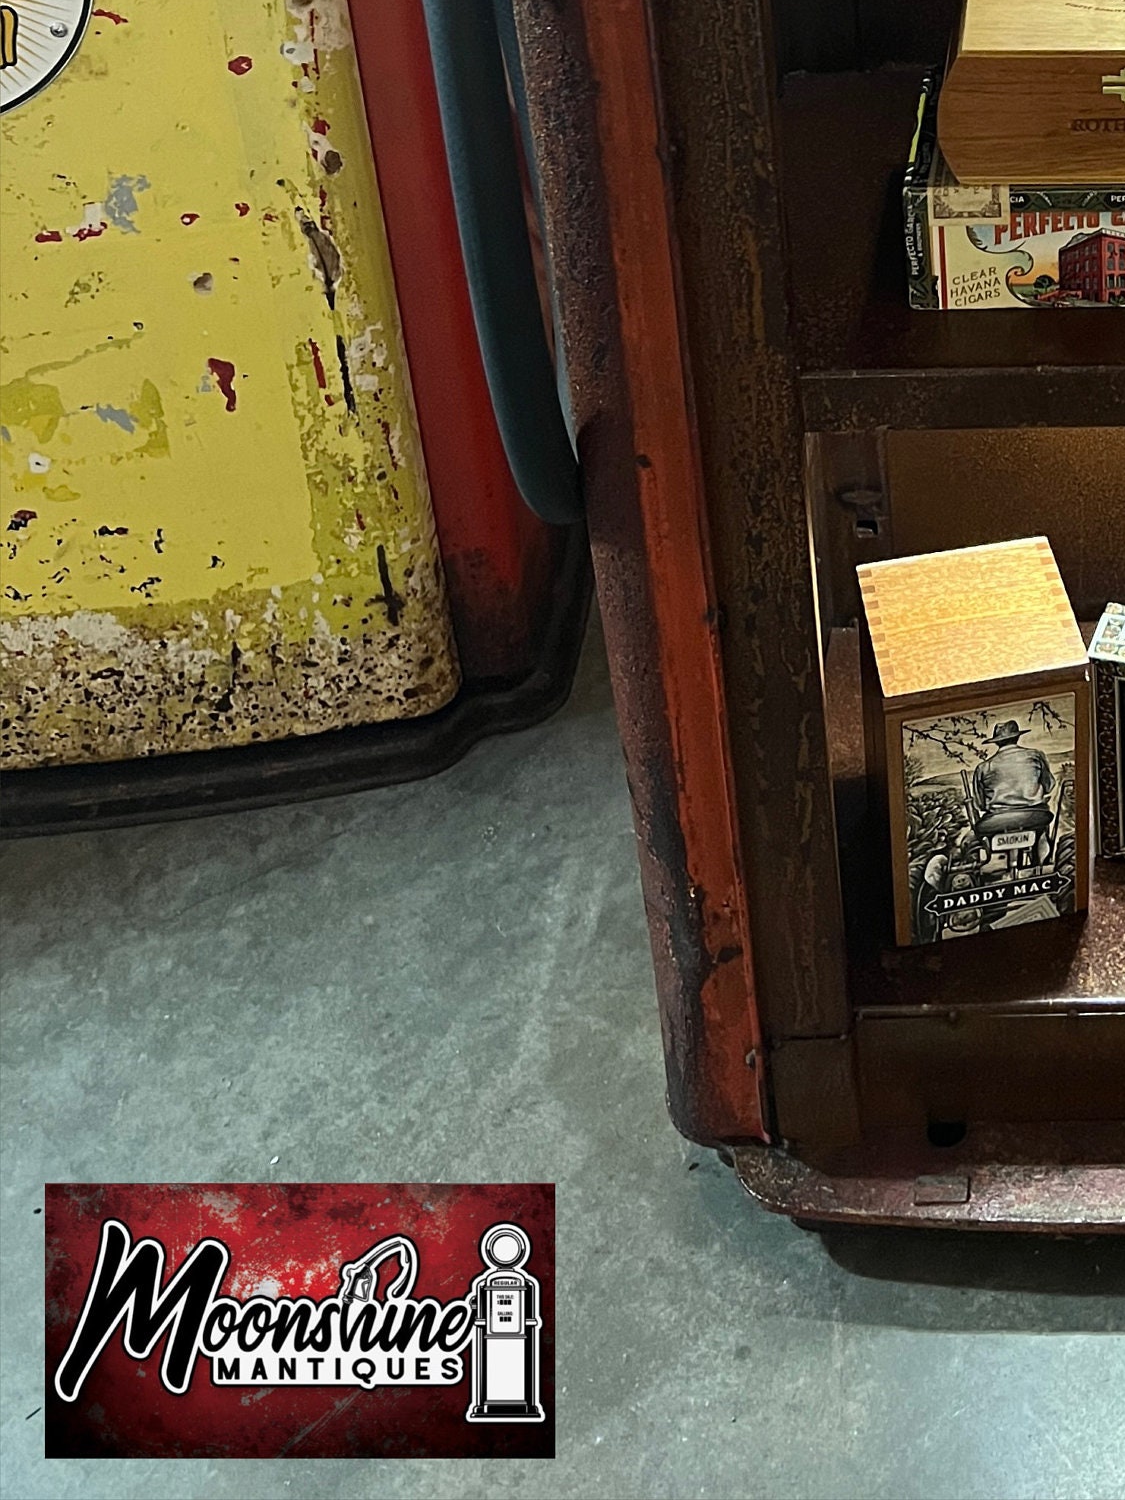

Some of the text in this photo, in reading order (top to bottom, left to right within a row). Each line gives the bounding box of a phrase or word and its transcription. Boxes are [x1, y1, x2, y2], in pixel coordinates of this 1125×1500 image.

[994, 211, 1100, 246] PERFECTO
[952, 266, 998, 286] CLEAR
[950, 277, 1001, 299] HAVANA
[954, 288, 1001, 307] CIGARS
[997, 833, 1029, 846] SMOKIN
[943, 880, 1051, 909] DADDY MAC
